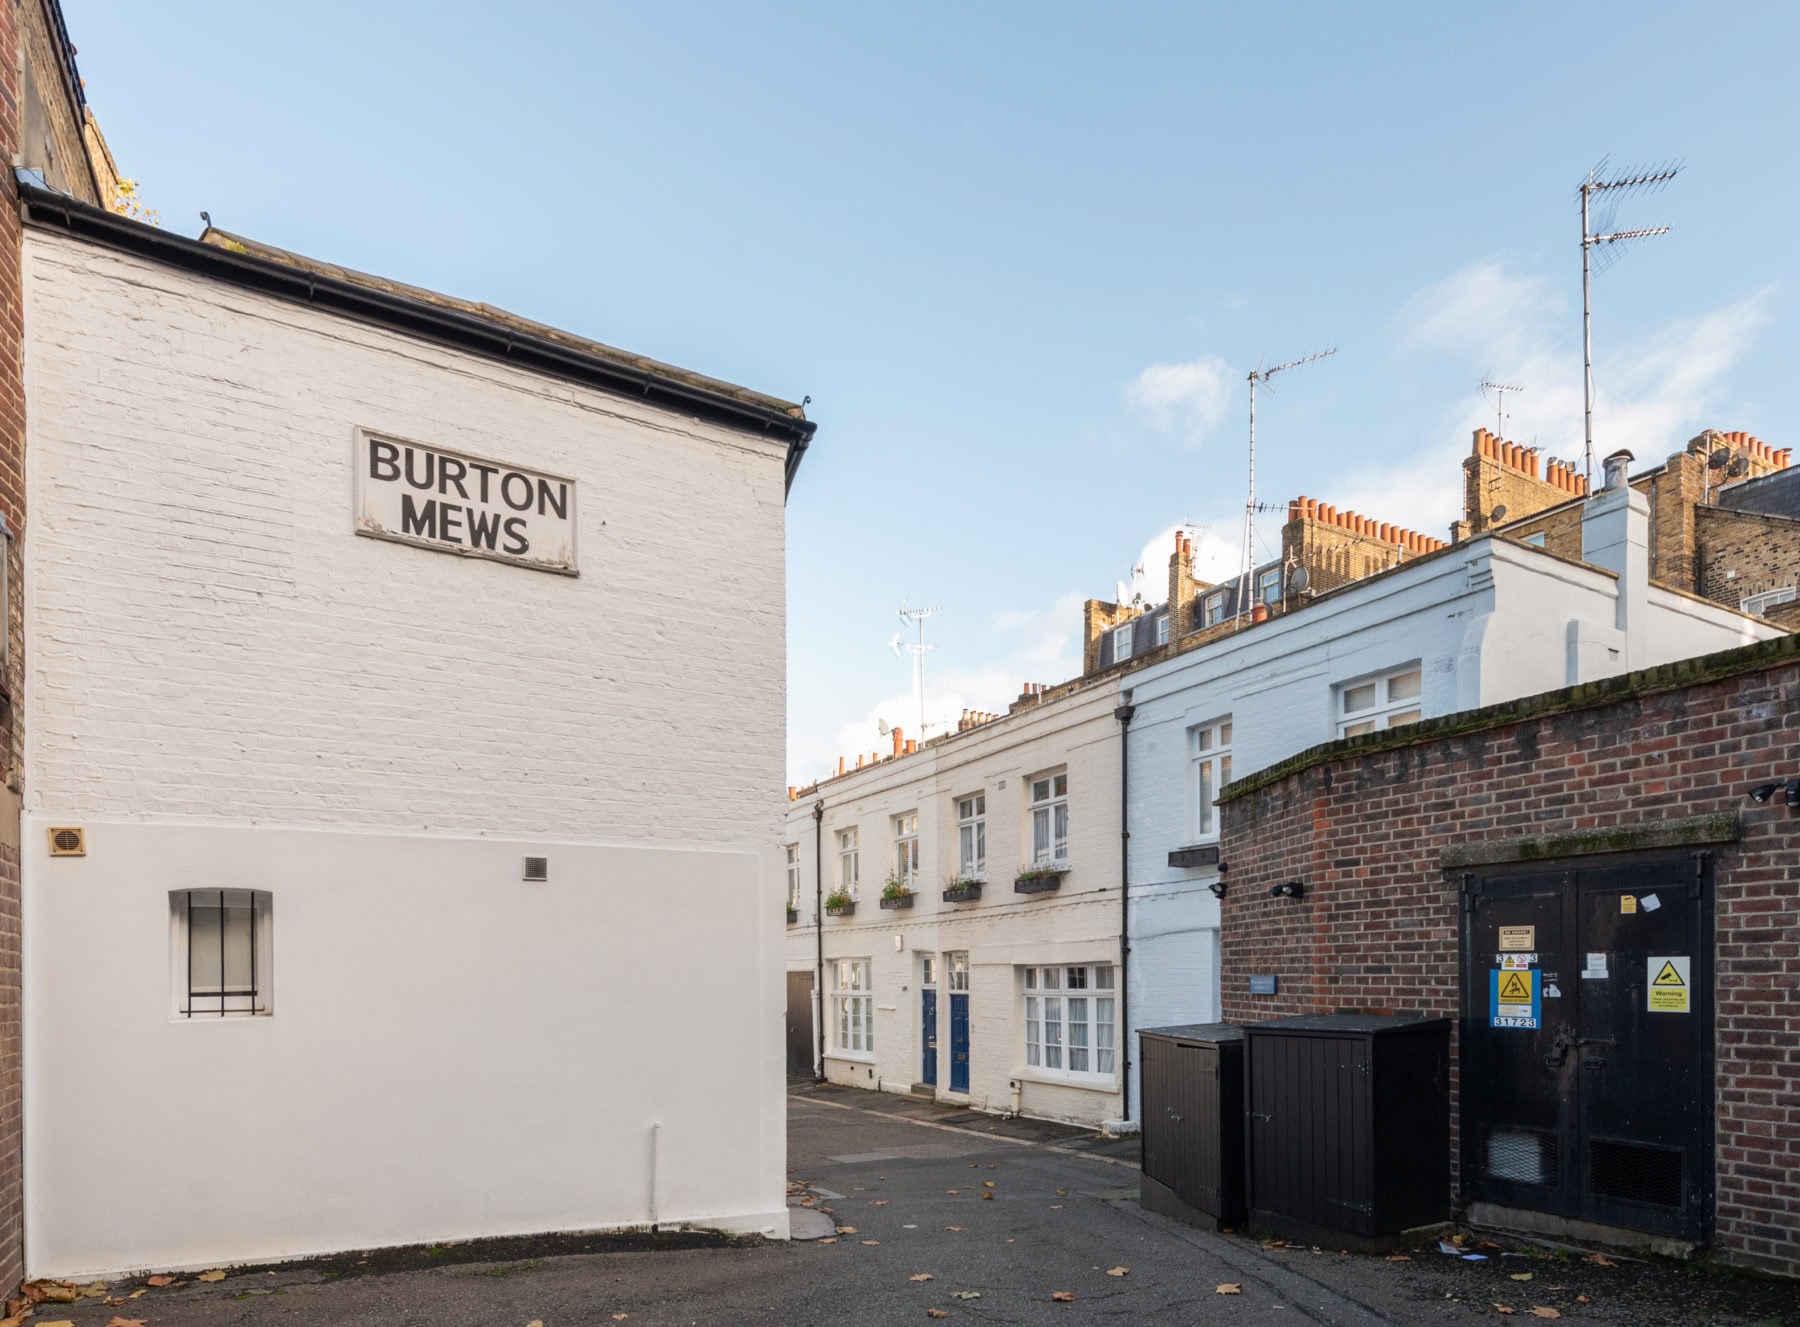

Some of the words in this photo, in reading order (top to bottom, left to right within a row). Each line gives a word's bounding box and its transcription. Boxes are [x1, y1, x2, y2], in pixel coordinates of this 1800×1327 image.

[370, 439, 567, 520] BURTON
[402, 493, 530, 555] MEWS
[1495, 1017, 1535, 1027] 31723
